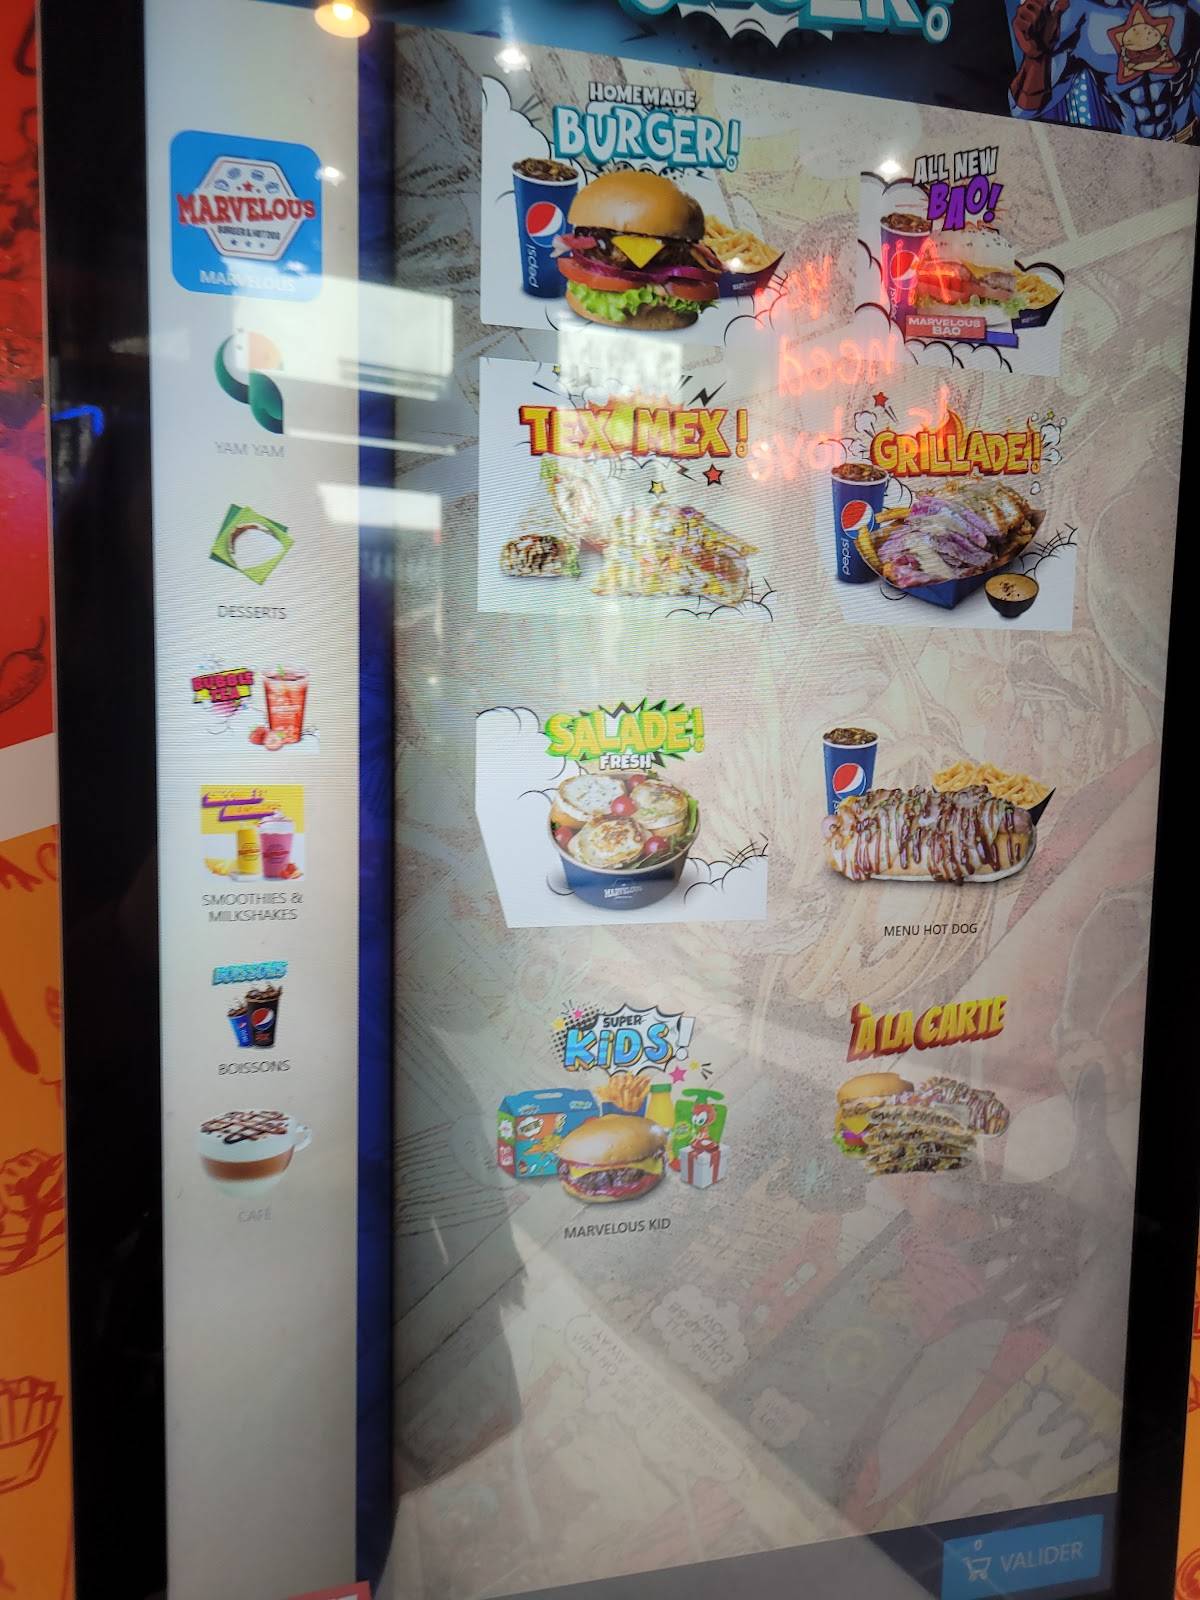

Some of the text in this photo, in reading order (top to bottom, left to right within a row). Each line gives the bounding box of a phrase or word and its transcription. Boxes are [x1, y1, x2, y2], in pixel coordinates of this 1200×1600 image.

[589, 82, 696, 108] HOMEMADE
[553, 105, 741, 172] BURGER!
[912, 146, 999, 187] ALL NEW
[176, 193, 316, 225] MARVELOUS
[927, 175, 1004, 231] BAO!
[908, 317, 981, 331] MARVELOUS
[930, 327, 963, 337] BAO
[519, 406, 620, 457] TEX
[630, 406, 732, 458] MEX
[213, 441, 286, 458] YAM YAM
[870, 430, 1042, 477] GRILLADE!
[840, 538, 852, 576] pepsi
[217, 605, 288, 620] DESSERTS
[545, 706, 705, 761] SALADE!
[600, 753, 653, 771] FRESH
[201, 892, 305, 907] SMOOTHIES &
[208, 908, 299, 923] MILKSHAKES
[883, 922, 978, 937] MENU HOT DOG
[602, 1014, 644, 1029] SUPER
[874, 1009, 914, 1056] LA
[914, 994, 1008, 1051] CARTE
[218, 1060, 291, 1076] BOISSONS
[563, 1217, 672, 1240] MARVELOUS KID
[1000, 1541, 1083, 1573] VALIDER
